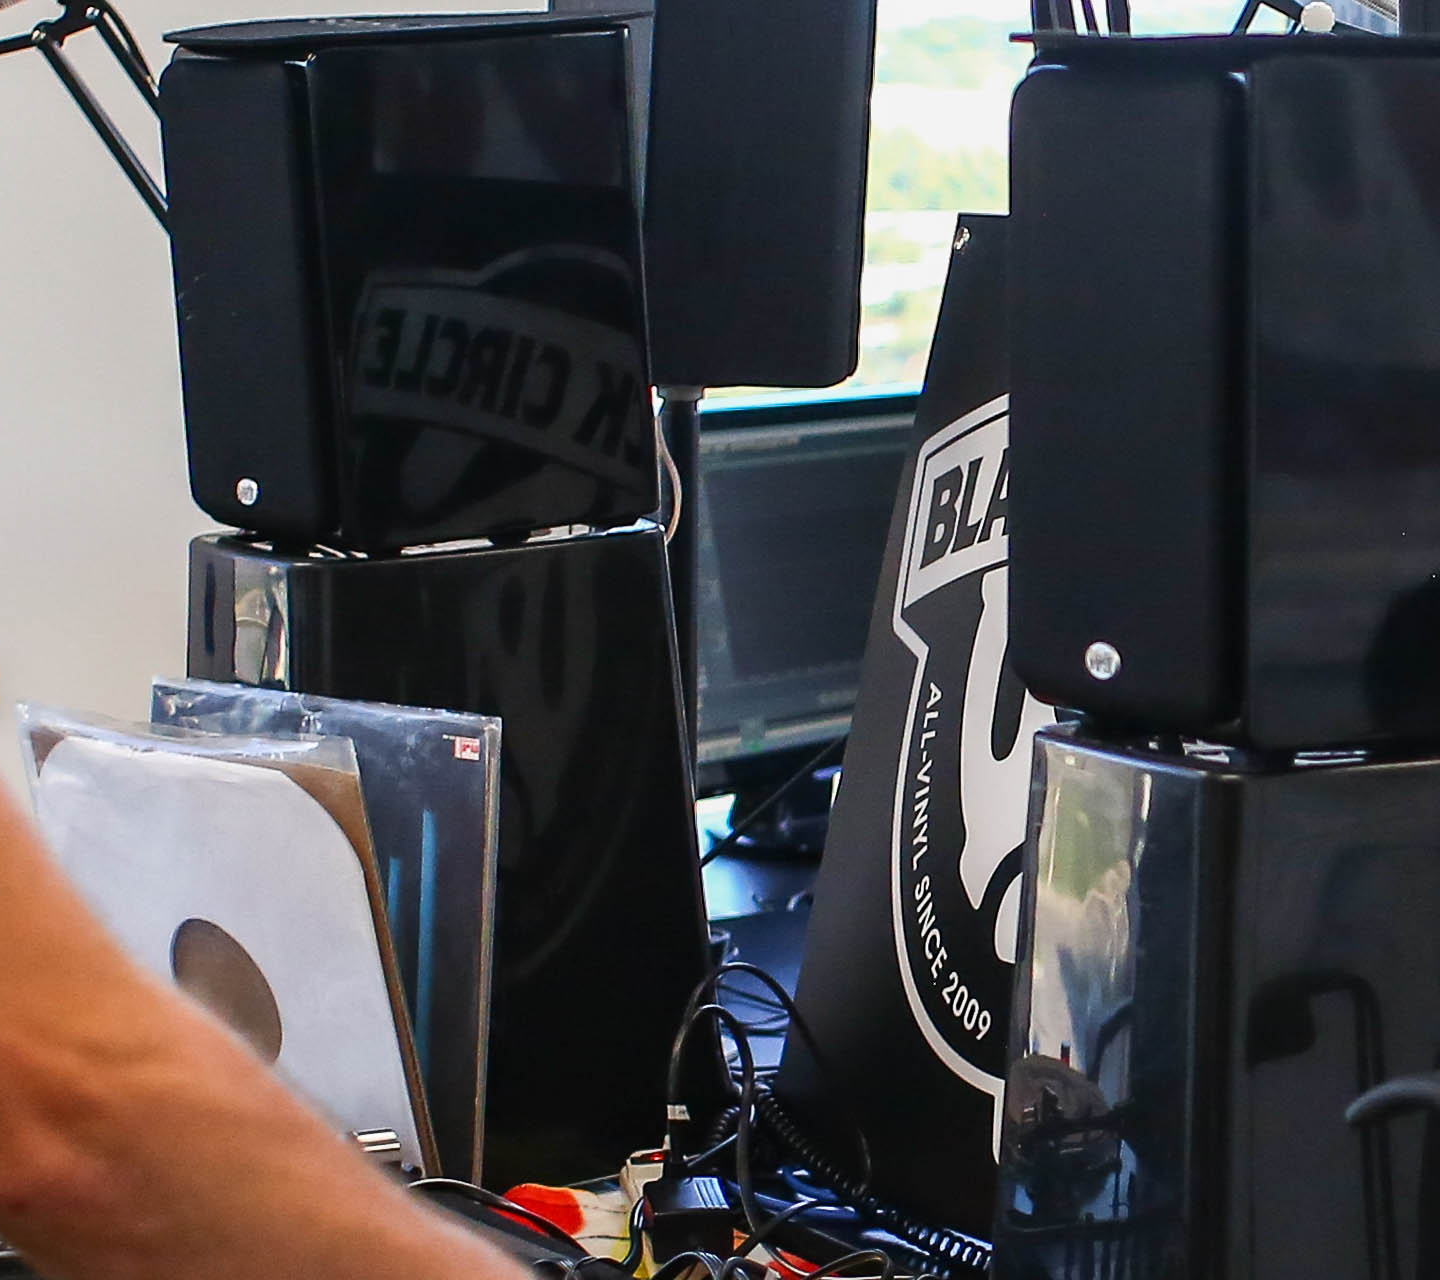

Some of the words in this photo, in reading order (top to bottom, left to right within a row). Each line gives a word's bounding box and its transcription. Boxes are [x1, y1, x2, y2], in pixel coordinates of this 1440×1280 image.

[911, 681, 943, 872] ALL-VINYL
[914, 874, 948, 980] SINCE
[941, 970, 992, 1042] 2009
